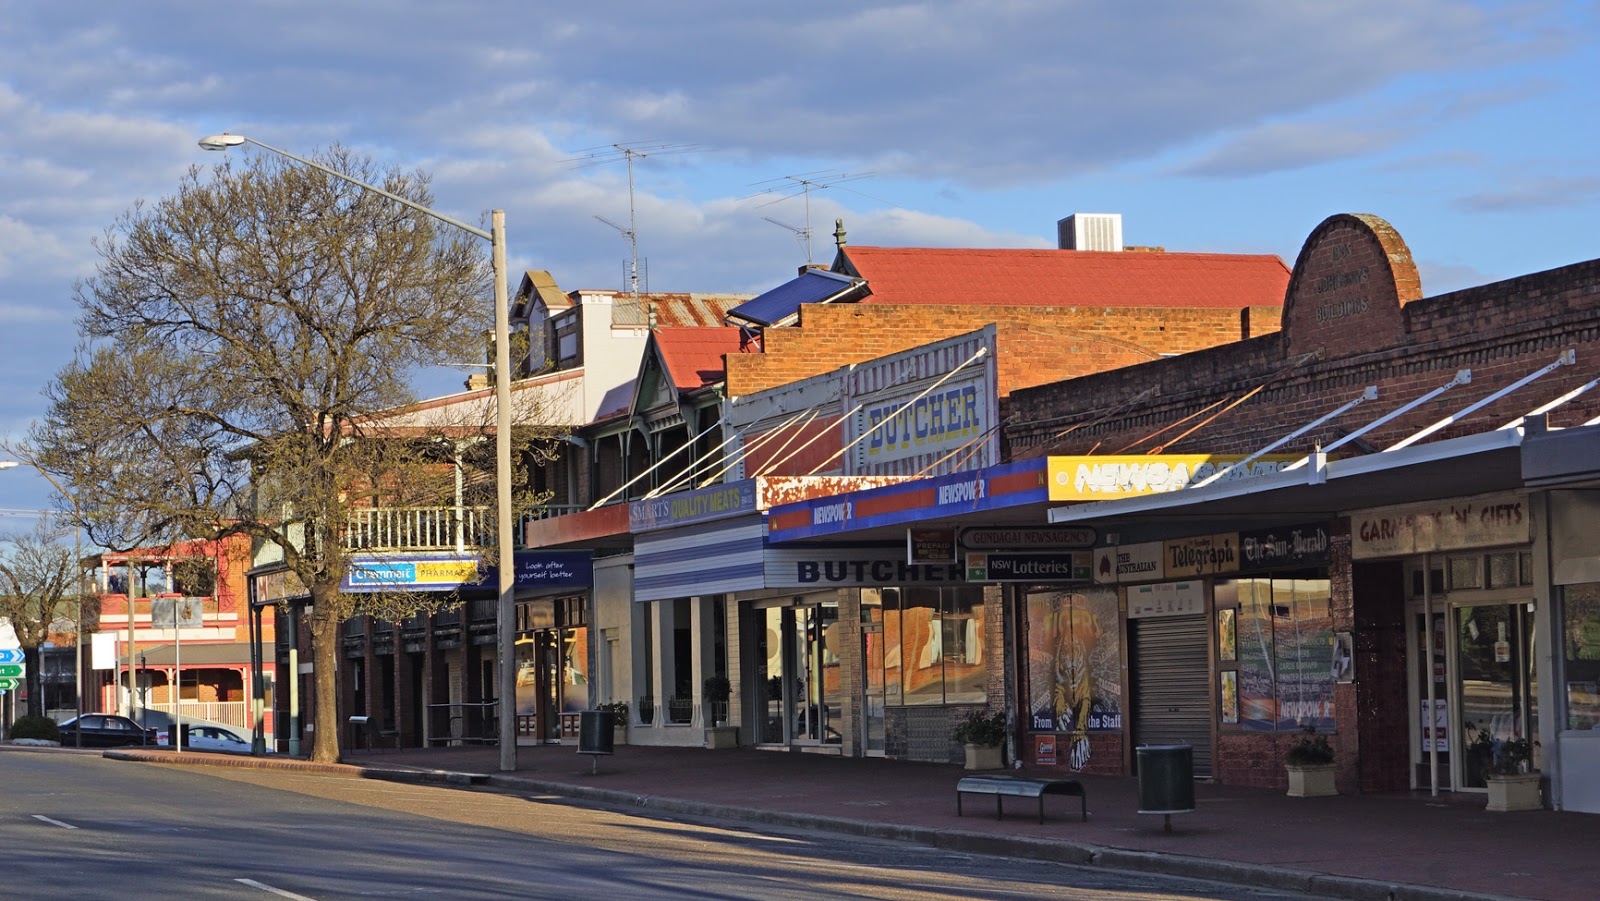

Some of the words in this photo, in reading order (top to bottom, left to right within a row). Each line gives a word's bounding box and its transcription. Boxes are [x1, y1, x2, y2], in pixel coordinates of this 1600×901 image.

[868, 386, 980, 453] BUTCHER
[632, 500, 669, 521] SMART'S
[671, 495, 708, 519] QUALITY
[709, 488, 740, 511] MEATS
[1480, 502, 1523, 527] GIFTS
[974, 532, 1022, 544] GUNDAGAI
[1024, 531, 1089, 543] NEWSAGENCY
[1117, 554, 1131, 564] THE
[1169, 539, 1235, 573] Telegraph
[525, 561, 543, 570] Look
[545, 561, 565, 570] after
[991, 560, 1012, 570] NSW
[1012, 559, 1069, 575] Lotteries
[1116, 561, 1157, 574] AUSTRALIAN
[420, 568, 475, 578] PHARMAC
[518, 570, 548, 583] yourself
[1033, 715, 1053, 728] From
[1102, 714, 1121, 728] Staff
